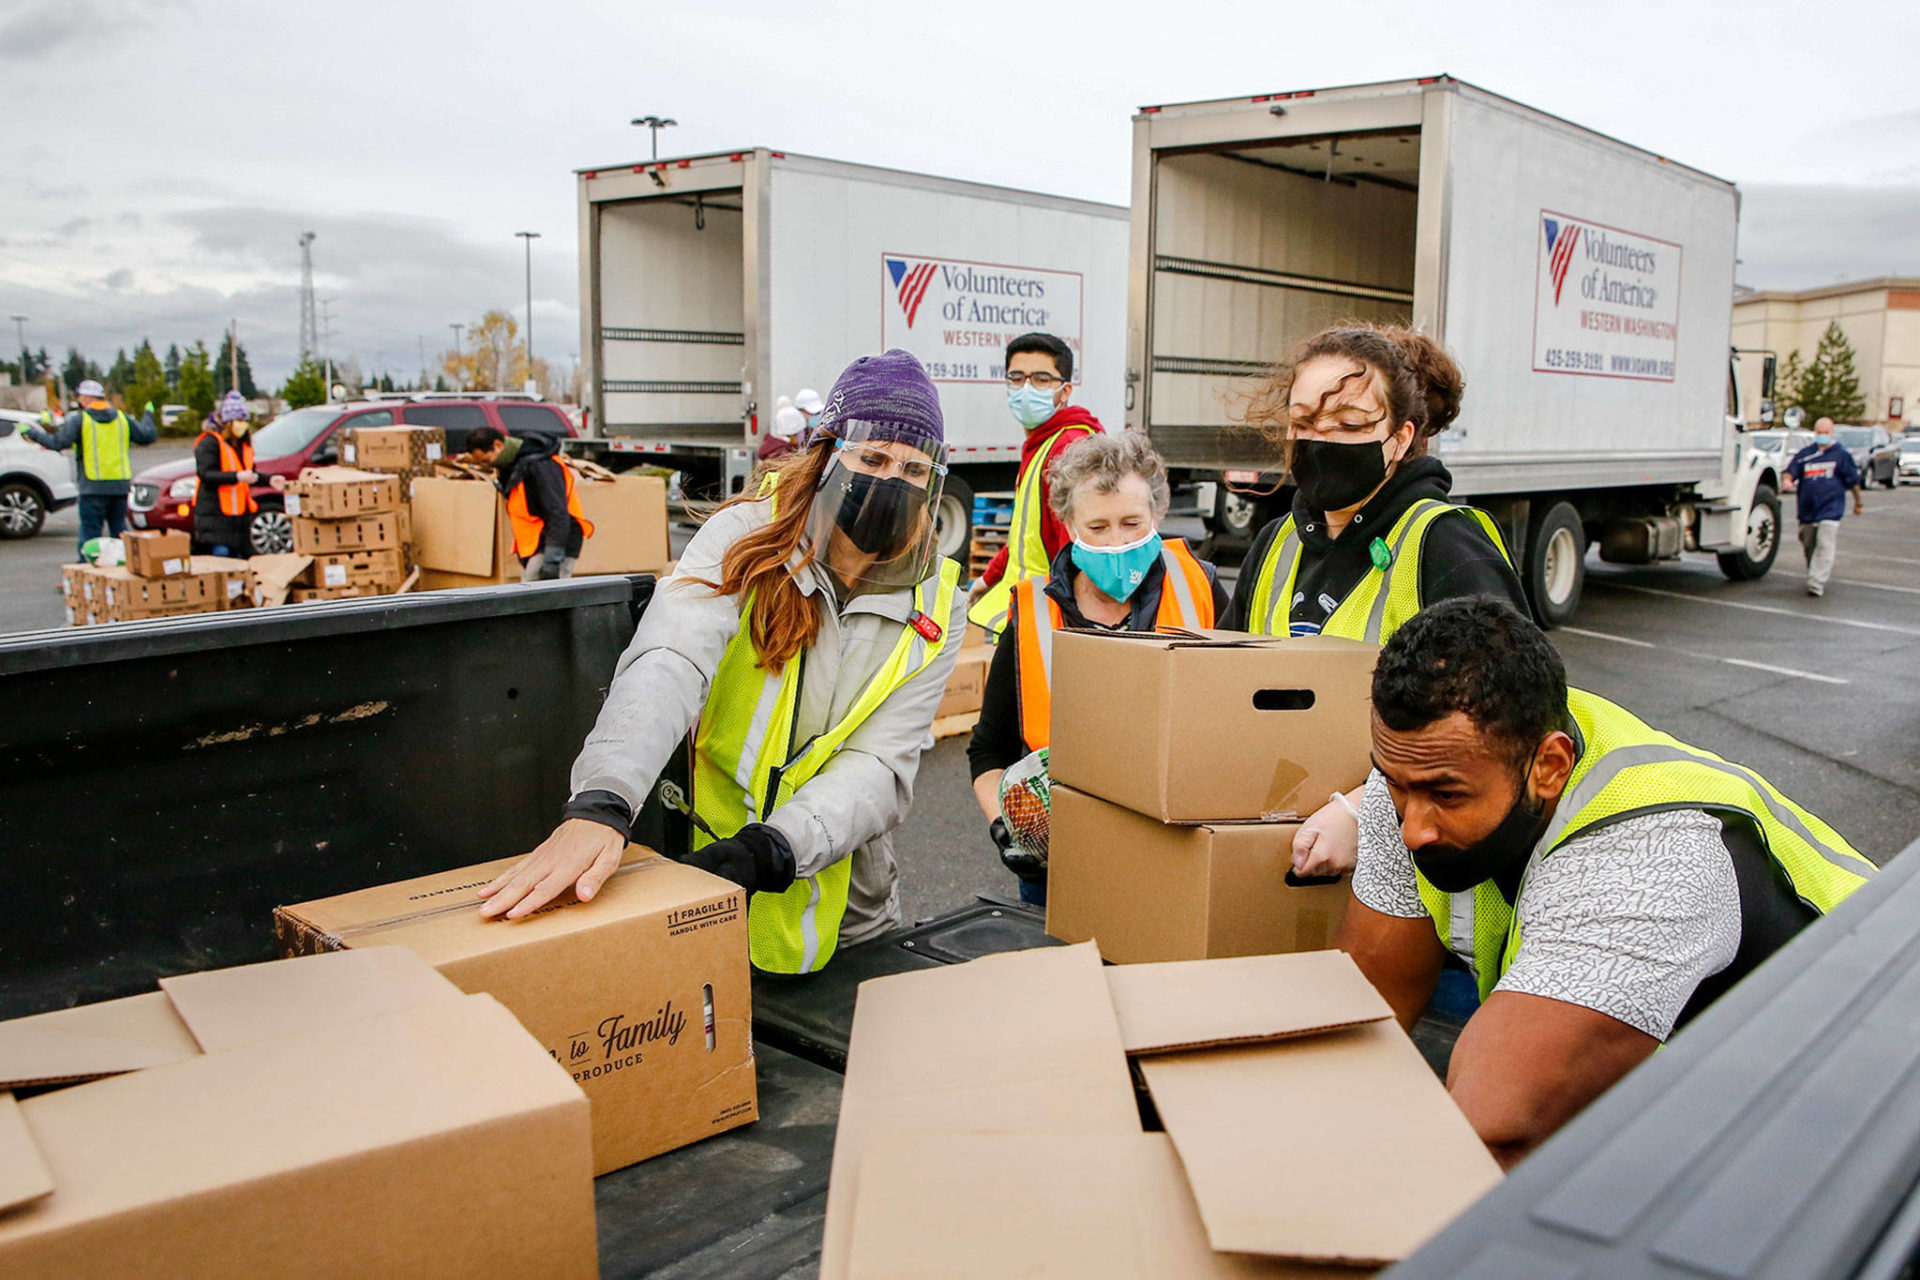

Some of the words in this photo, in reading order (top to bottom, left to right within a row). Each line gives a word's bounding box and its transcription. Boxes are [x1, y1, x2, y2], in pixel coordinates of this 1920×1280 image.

[1583, 227, 1656, 275] Volunteers
[941, 265, 1045, 298] Volunteers
[1581, 268, 1599, 300] of
[1599, 272, 1656, 309] America
[942, 298, 966, 322] of
[968, 301, 1047, 327] America
[1580, 310, 1622, 333] WESTERN
[1623, 316, 1677, 341] WASHINGTON
[943, 330, 1000, 347] WESTERN
[926, 363, 979, 378] 259-3191
[1545, 348, 1604, 371] 425-259-3191
[669, 924, 698, 937] HANDLE
[699, 919, 718, 929] WITH
[719, 914, 737, 924] CARE
[681, 901, 725, 920] FRAGILE
[570, 1038, 590, 1060] to
[597, 1000, 687, 1059] Family
[572, 1052, 644, 1083] PRODUCE
